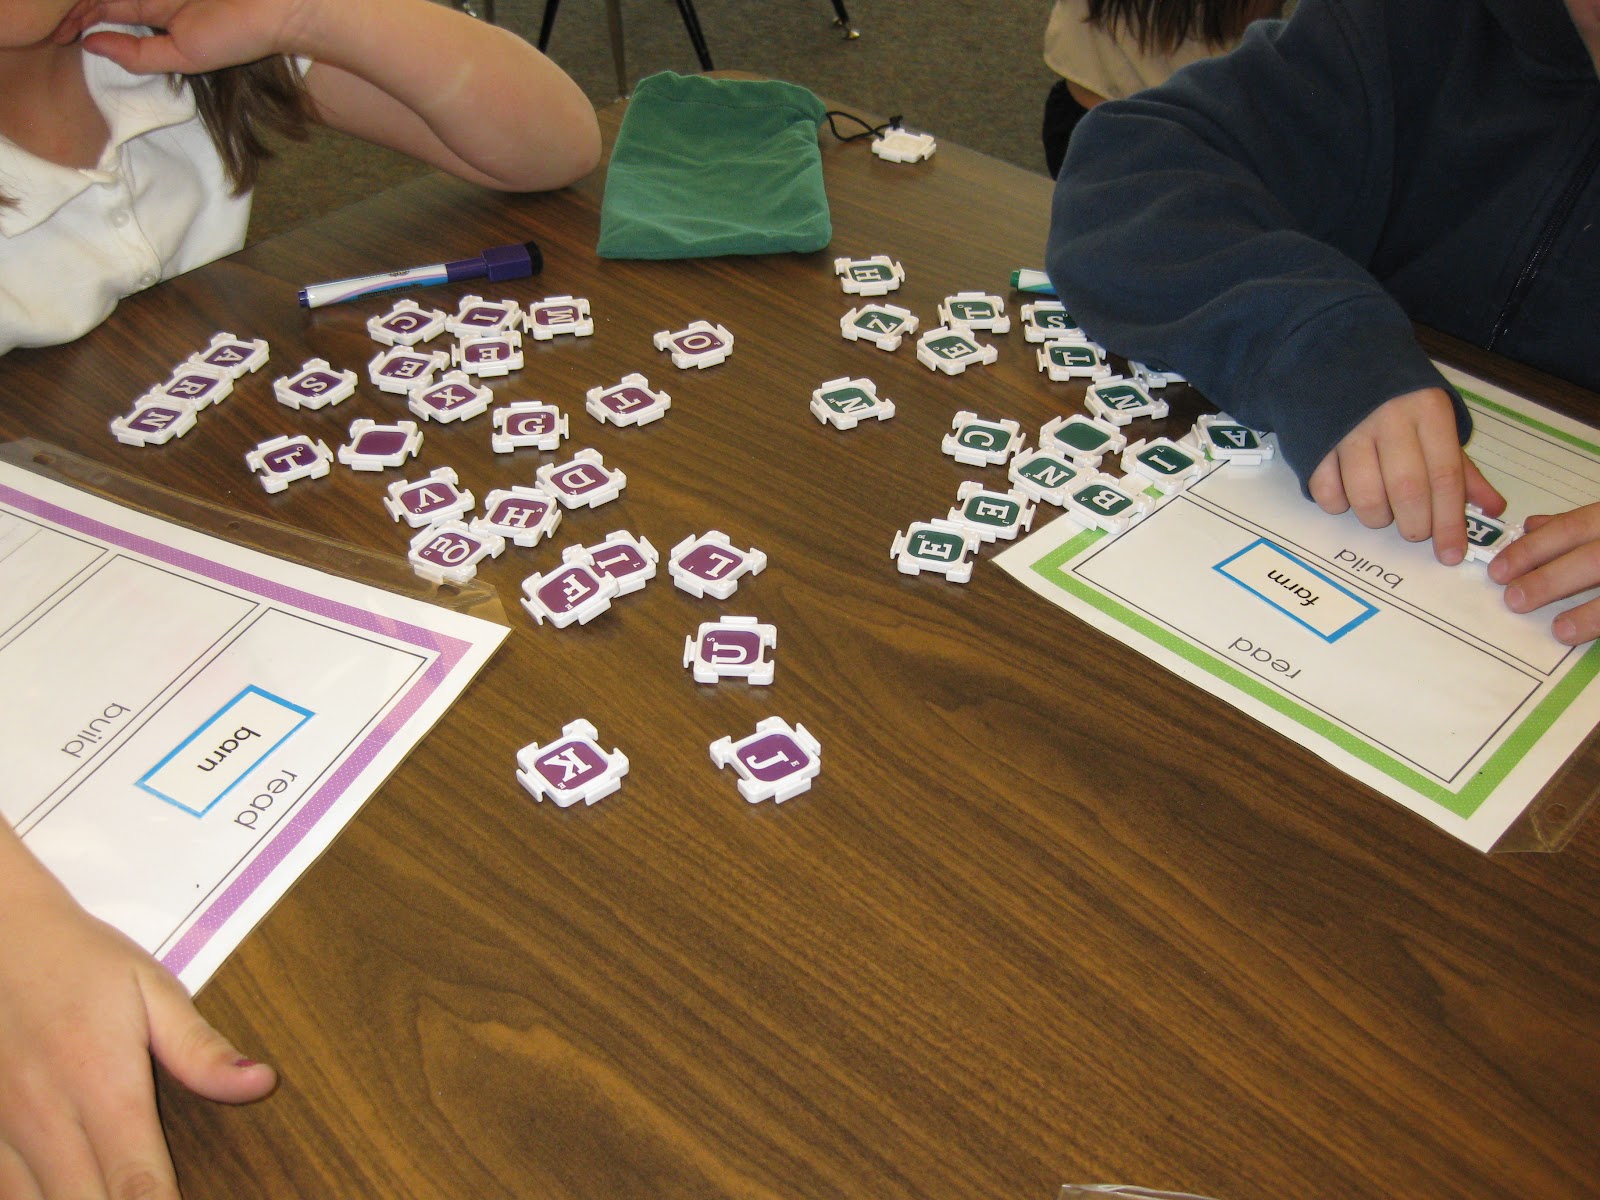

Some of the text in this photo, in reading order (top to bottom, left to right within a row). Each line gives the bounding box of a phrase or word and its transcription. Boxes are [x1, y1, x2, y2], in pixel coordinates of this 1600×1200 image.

[854, 268, 882, 281] H
[390, 316, 418, 330] C
[964, 306, 991, 320] T
[1047, 315, 1066, 329] S
[683, 335, 712, 350] O
[941, 342, 973, 359] E
[213, 348, 244, 362] A
[478, 347, 500, 362] E
[1062, 351, 1091, 366] T
[394, 360, 424, 377] E
[171, 379, 208, 395] R
[300, 376, 328, 392] S
[431, 387, 466, 407] X
[611, 392, 642, 411] T
[140, 411, 175, 429] N
[518, 417, 545, 435] G
[963, 430, 995, 447] C
[1221, 430, 1248, 447] A
[274, 451, 302, 471] T
[1148, 454, 1178, 472] I
[561, 468, 596, 489] D
[1032, 465, 1070, 487] N
[419, 487, 446, 508] V
[1092, 489, 1126, 511] B
[498, 506, 535, 528] H
[975, 500, 1010, 520] E
[1467, 518, 1494, 542] R
[429, 536, 471, 563] Qu
[917, 539, 953, 560] E
[596, 552, 631, 570] I
[704, 552, 734, 578] L
[1333, 548, 1404, 589] build
[562, 573, 592, 603] F
[1267, 569, 1320, 607] farm
[711, 642, 747, 665] U
[1227, 636, 1302, 679] read
[61, 702, 131, 758] build
[197, 726, 262, 772] barn
[543, 746, 593, 783] K
[746, 750, 790, 770] J
[234, 769, 298, 830] read
